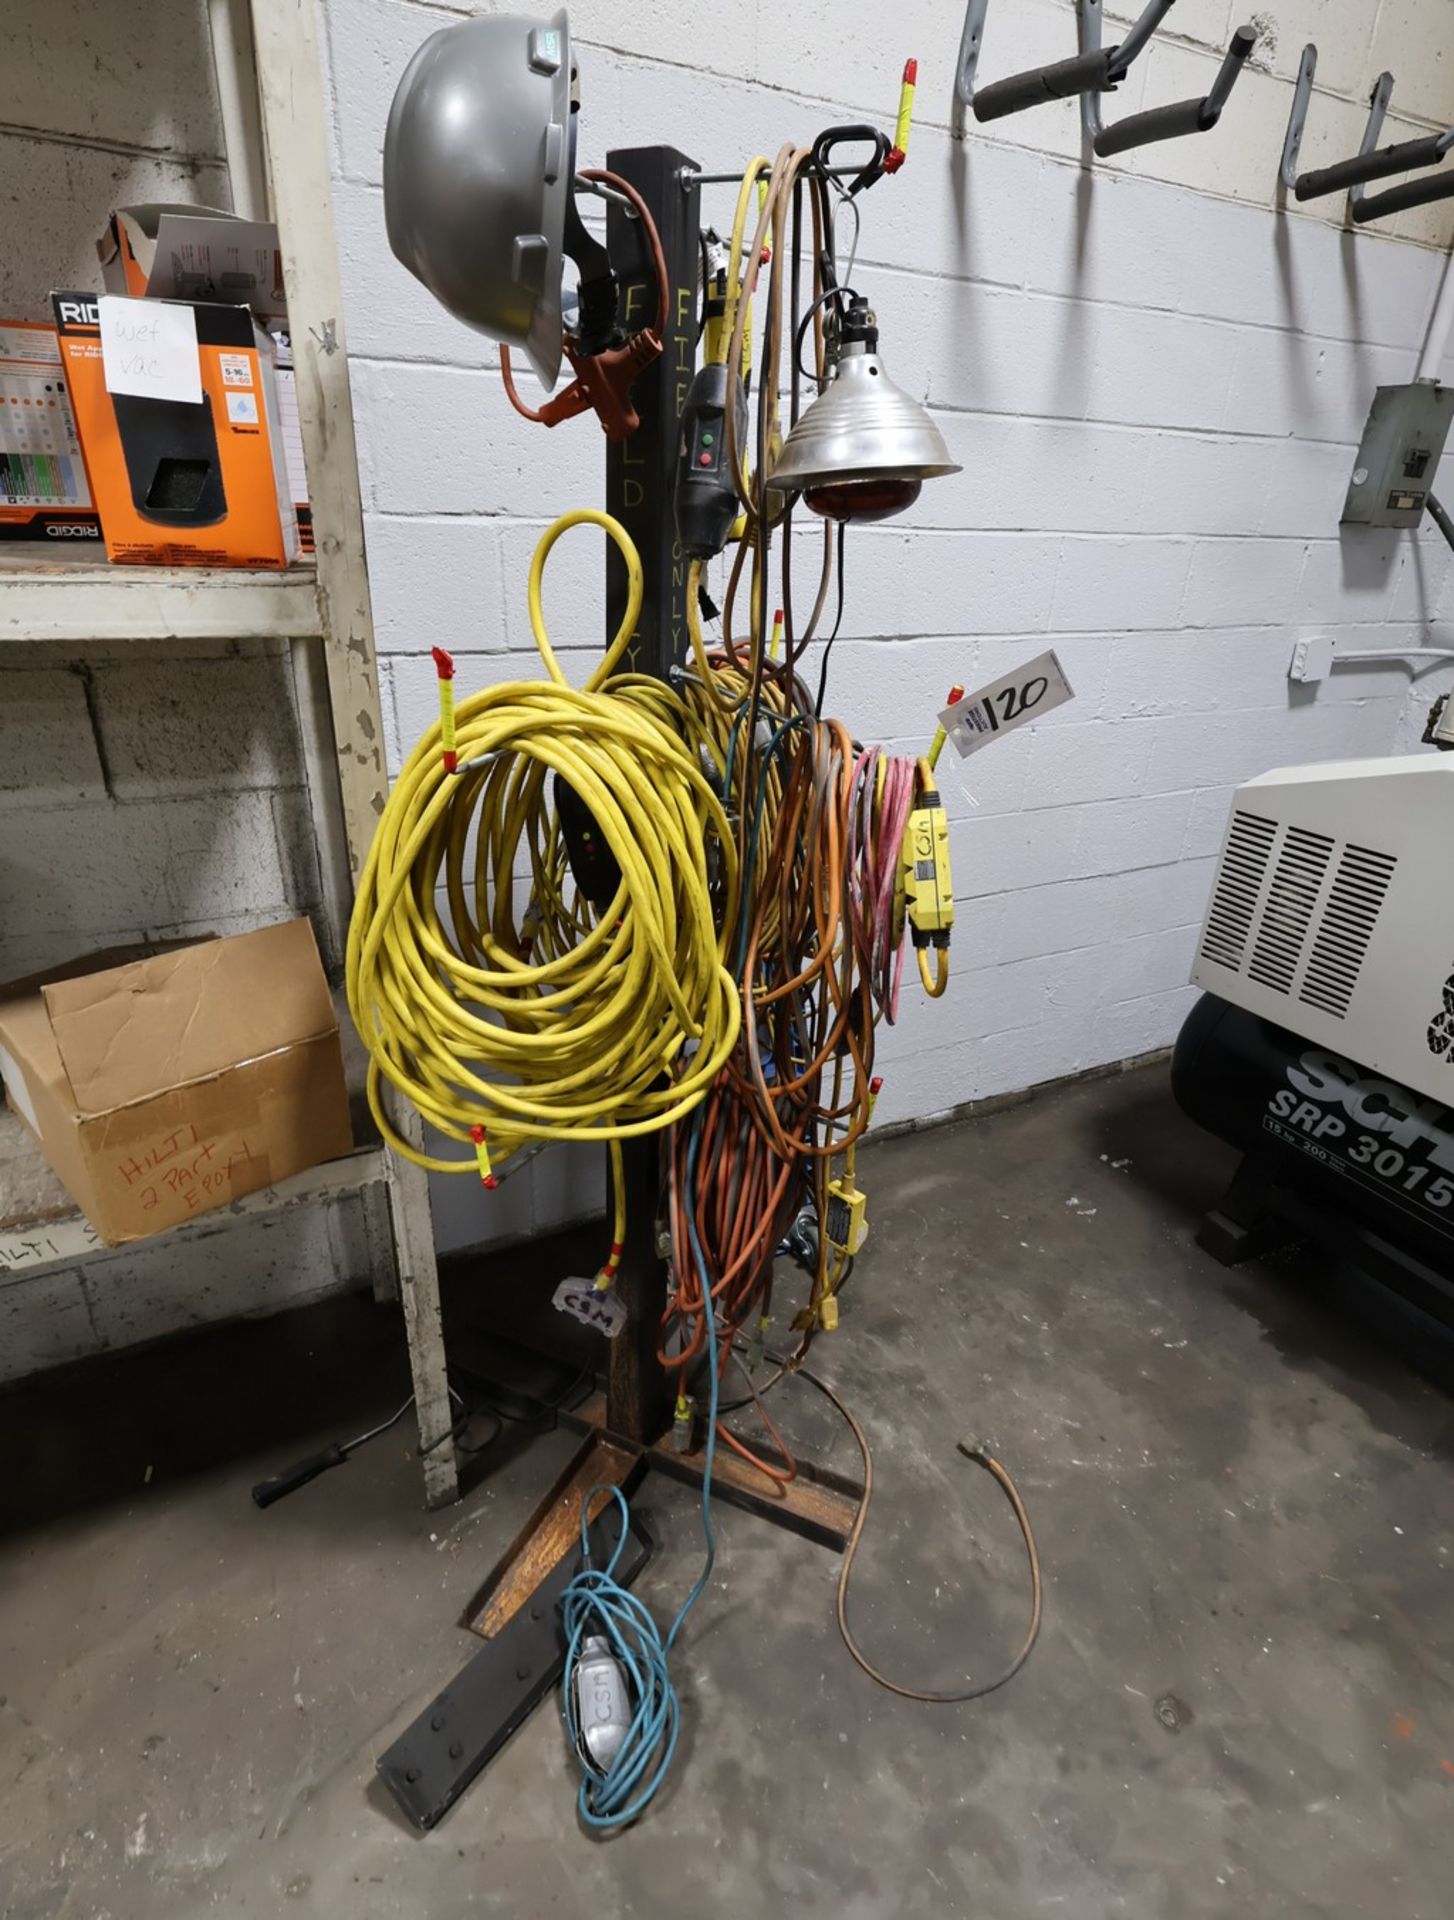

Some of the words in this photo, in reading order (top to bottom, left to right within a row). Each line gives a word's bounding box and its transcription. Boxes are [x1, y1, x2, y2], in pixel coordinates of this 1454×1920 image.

[59, 302, 99, 323] RID
[673, 288, 692, 418] FIE
[46, 525, 99, 537] RIDGID
[982, 677, 1049, 732] 120
[118, 1124, 198, 1186] HILTI
[1268, 1120, 1281, 1134] 15
[1304, 1141, 1327, 1161] 200
[1268, 1089, 1346, 1139] SRP
[1348, 1135, 1454, 1208] 3015
[139, 1187, 161, 1211] 2
[0, 1238, 59, 1264] ILTI
